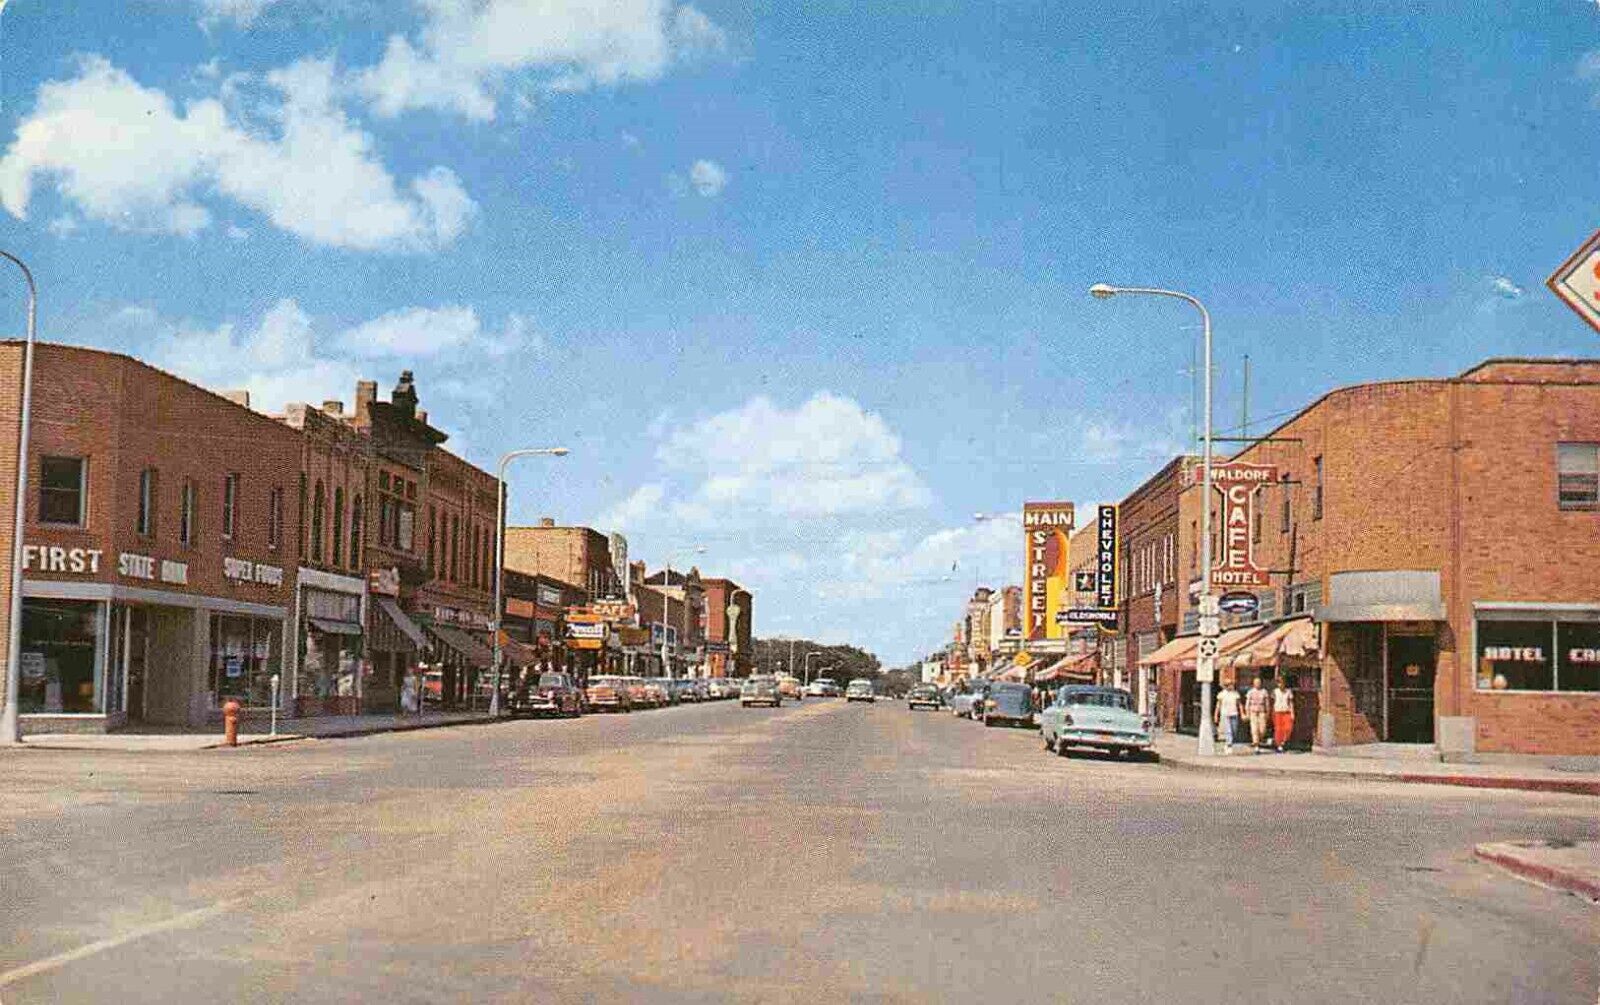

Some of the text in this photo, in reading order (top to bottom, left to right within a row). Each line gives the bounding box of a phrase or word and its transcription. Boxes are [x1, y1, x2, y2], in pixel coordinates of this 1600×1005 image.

[1210, 469, 1270, 481] WALDORF
[1025, 512, 1072, 525] MAIN
[1229, 485, 1247, 568] CAFE
[22, 545, 103, 573] FIRST
[1101, 508, 1113, 606] CHEVROLET
[1032, 531, 1047, 627] STREET
[1212, 571, 1260, 584] HOTEL
[1484, 646, 1546, 661] HOTEL
